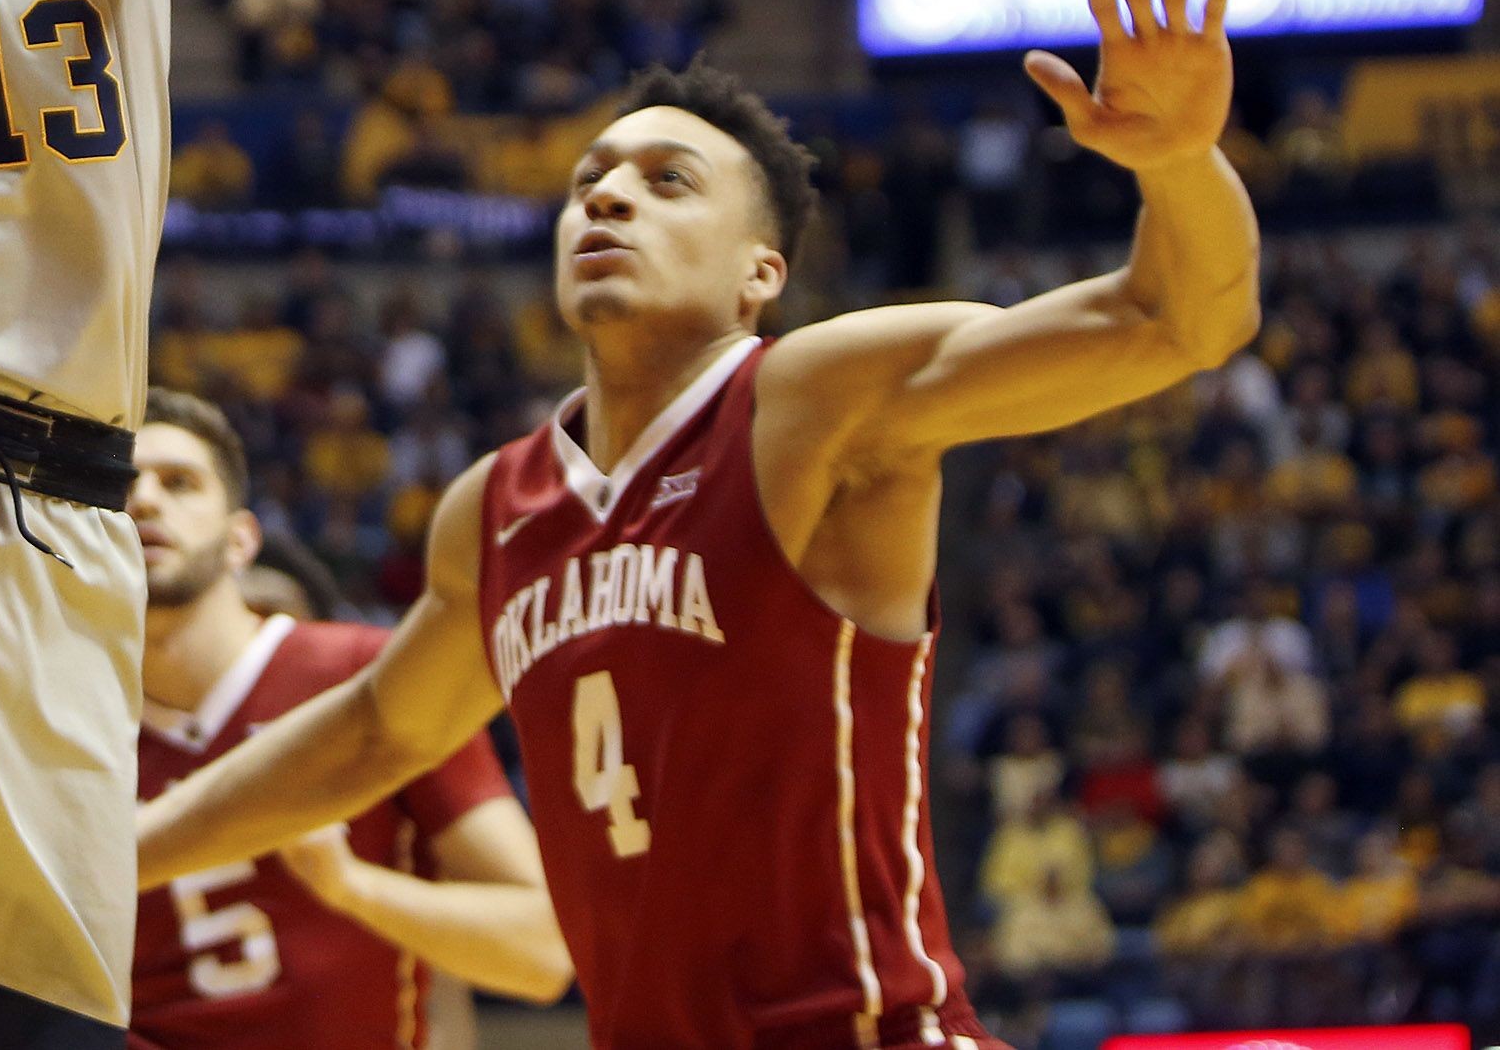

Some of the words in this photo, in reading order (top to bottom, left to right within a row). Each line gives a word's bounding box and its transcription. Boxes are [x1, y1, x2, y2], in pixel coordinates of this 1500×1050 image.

[492, 542, 727, 705] OKLAHOMA
[571, 669, 652, 860] 4
[170, 859, 283, 998] 5
